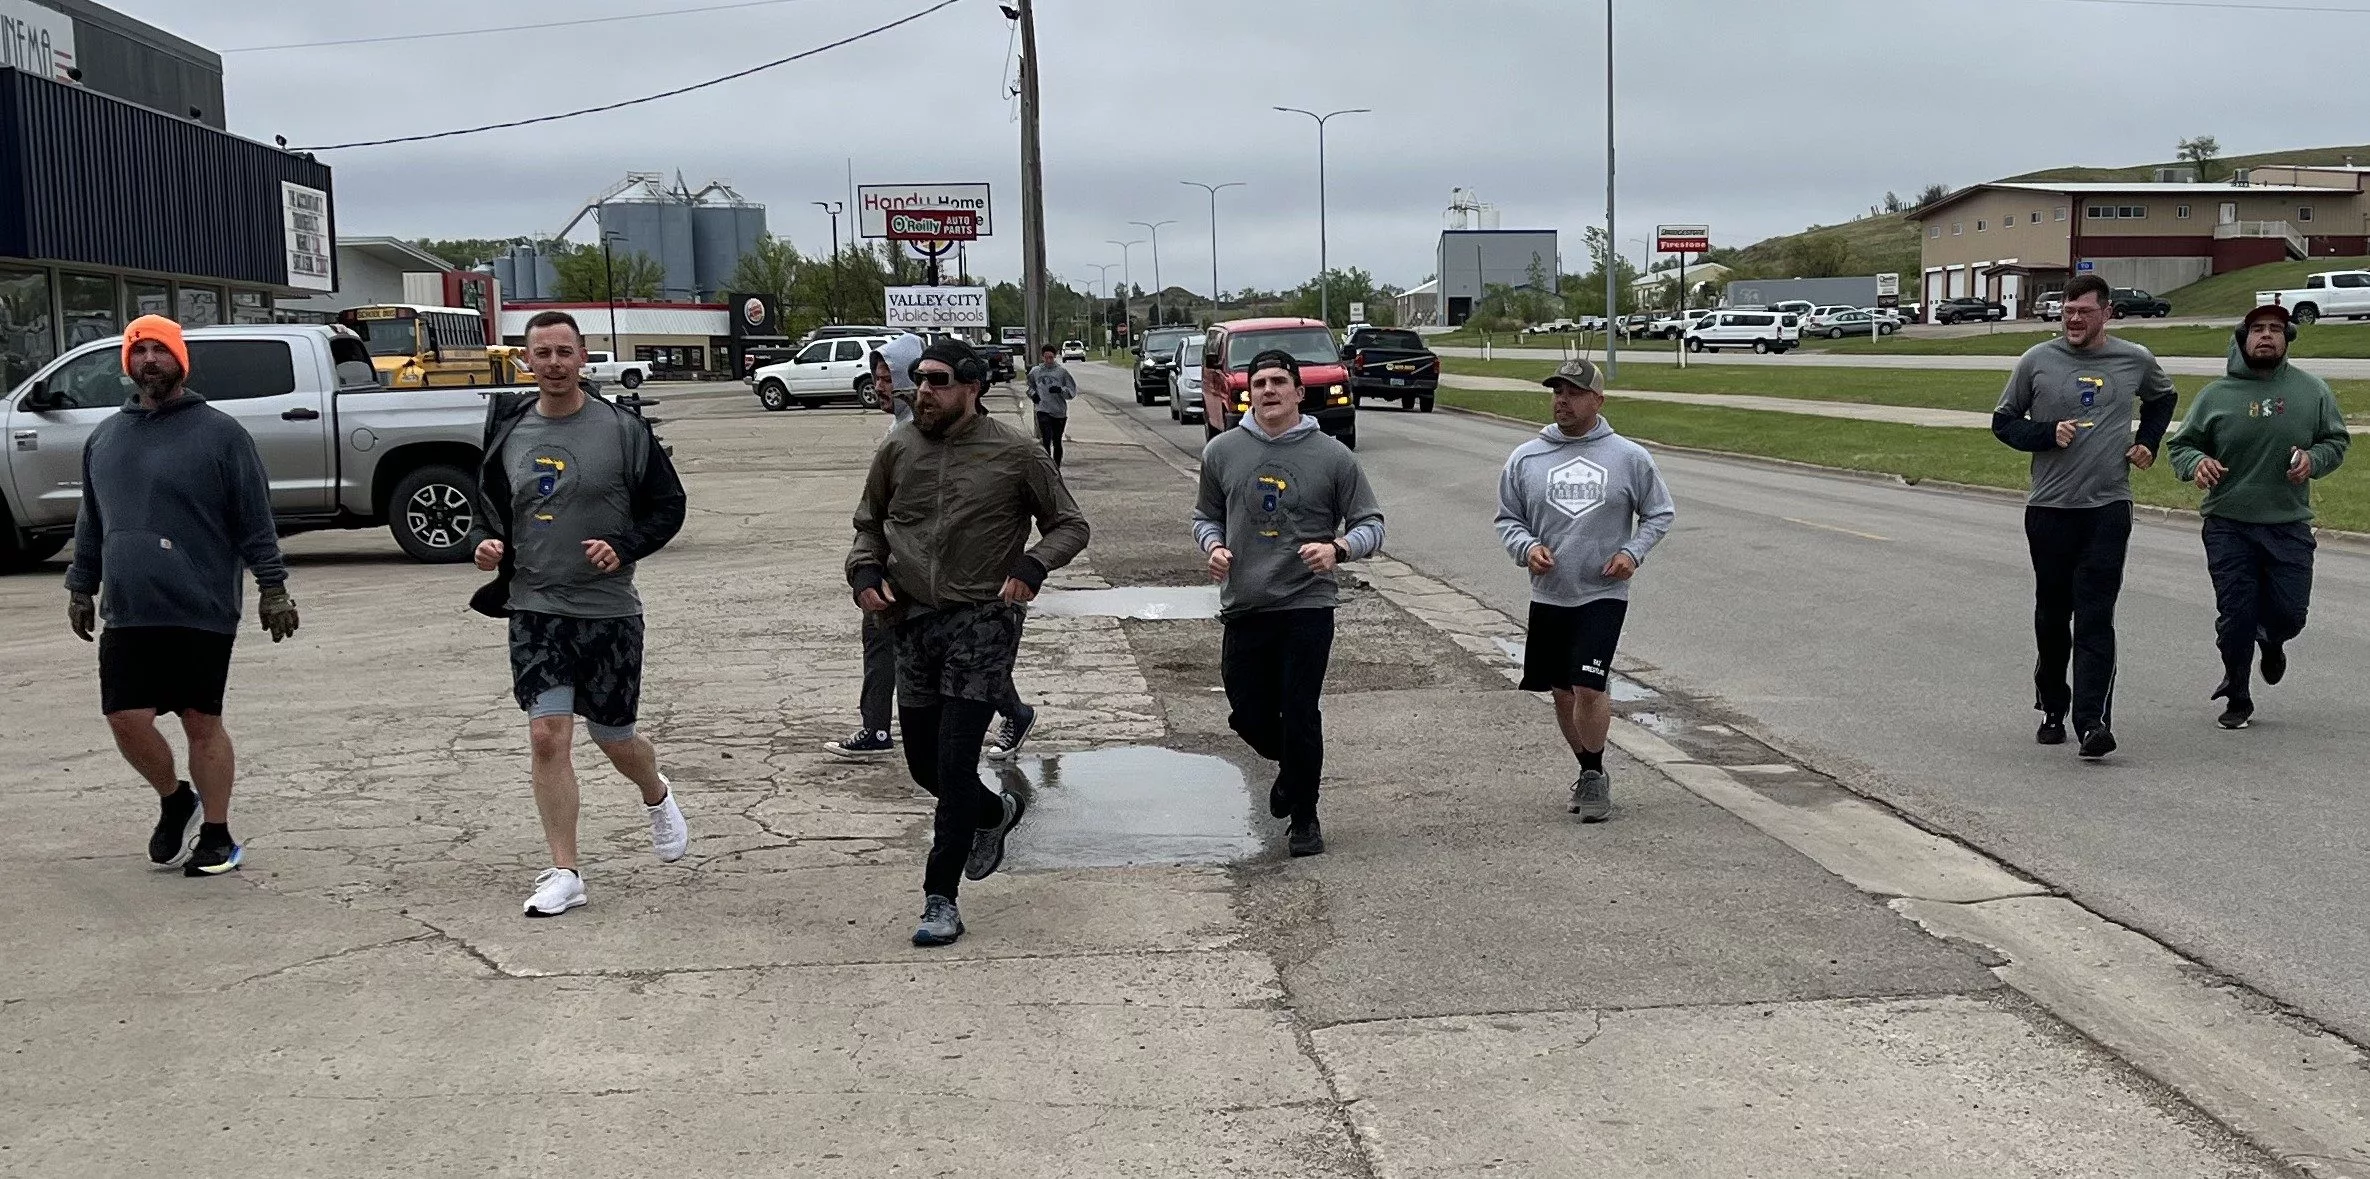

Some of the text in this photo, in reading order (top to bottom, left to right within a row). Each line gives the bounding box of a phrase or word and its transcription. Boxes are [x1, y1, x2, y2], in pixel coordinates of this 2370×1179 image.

[893, 216, 940, 234] O'Reilly
[946, 216, 970, 225] AUTO
[943, 225, 973, 235] PARTS
[1661, 241, 1706, 249] Firestone
[889, 294, 983, 306] VALLEY CITY
[889, 308, 984, 322] Public Schools
